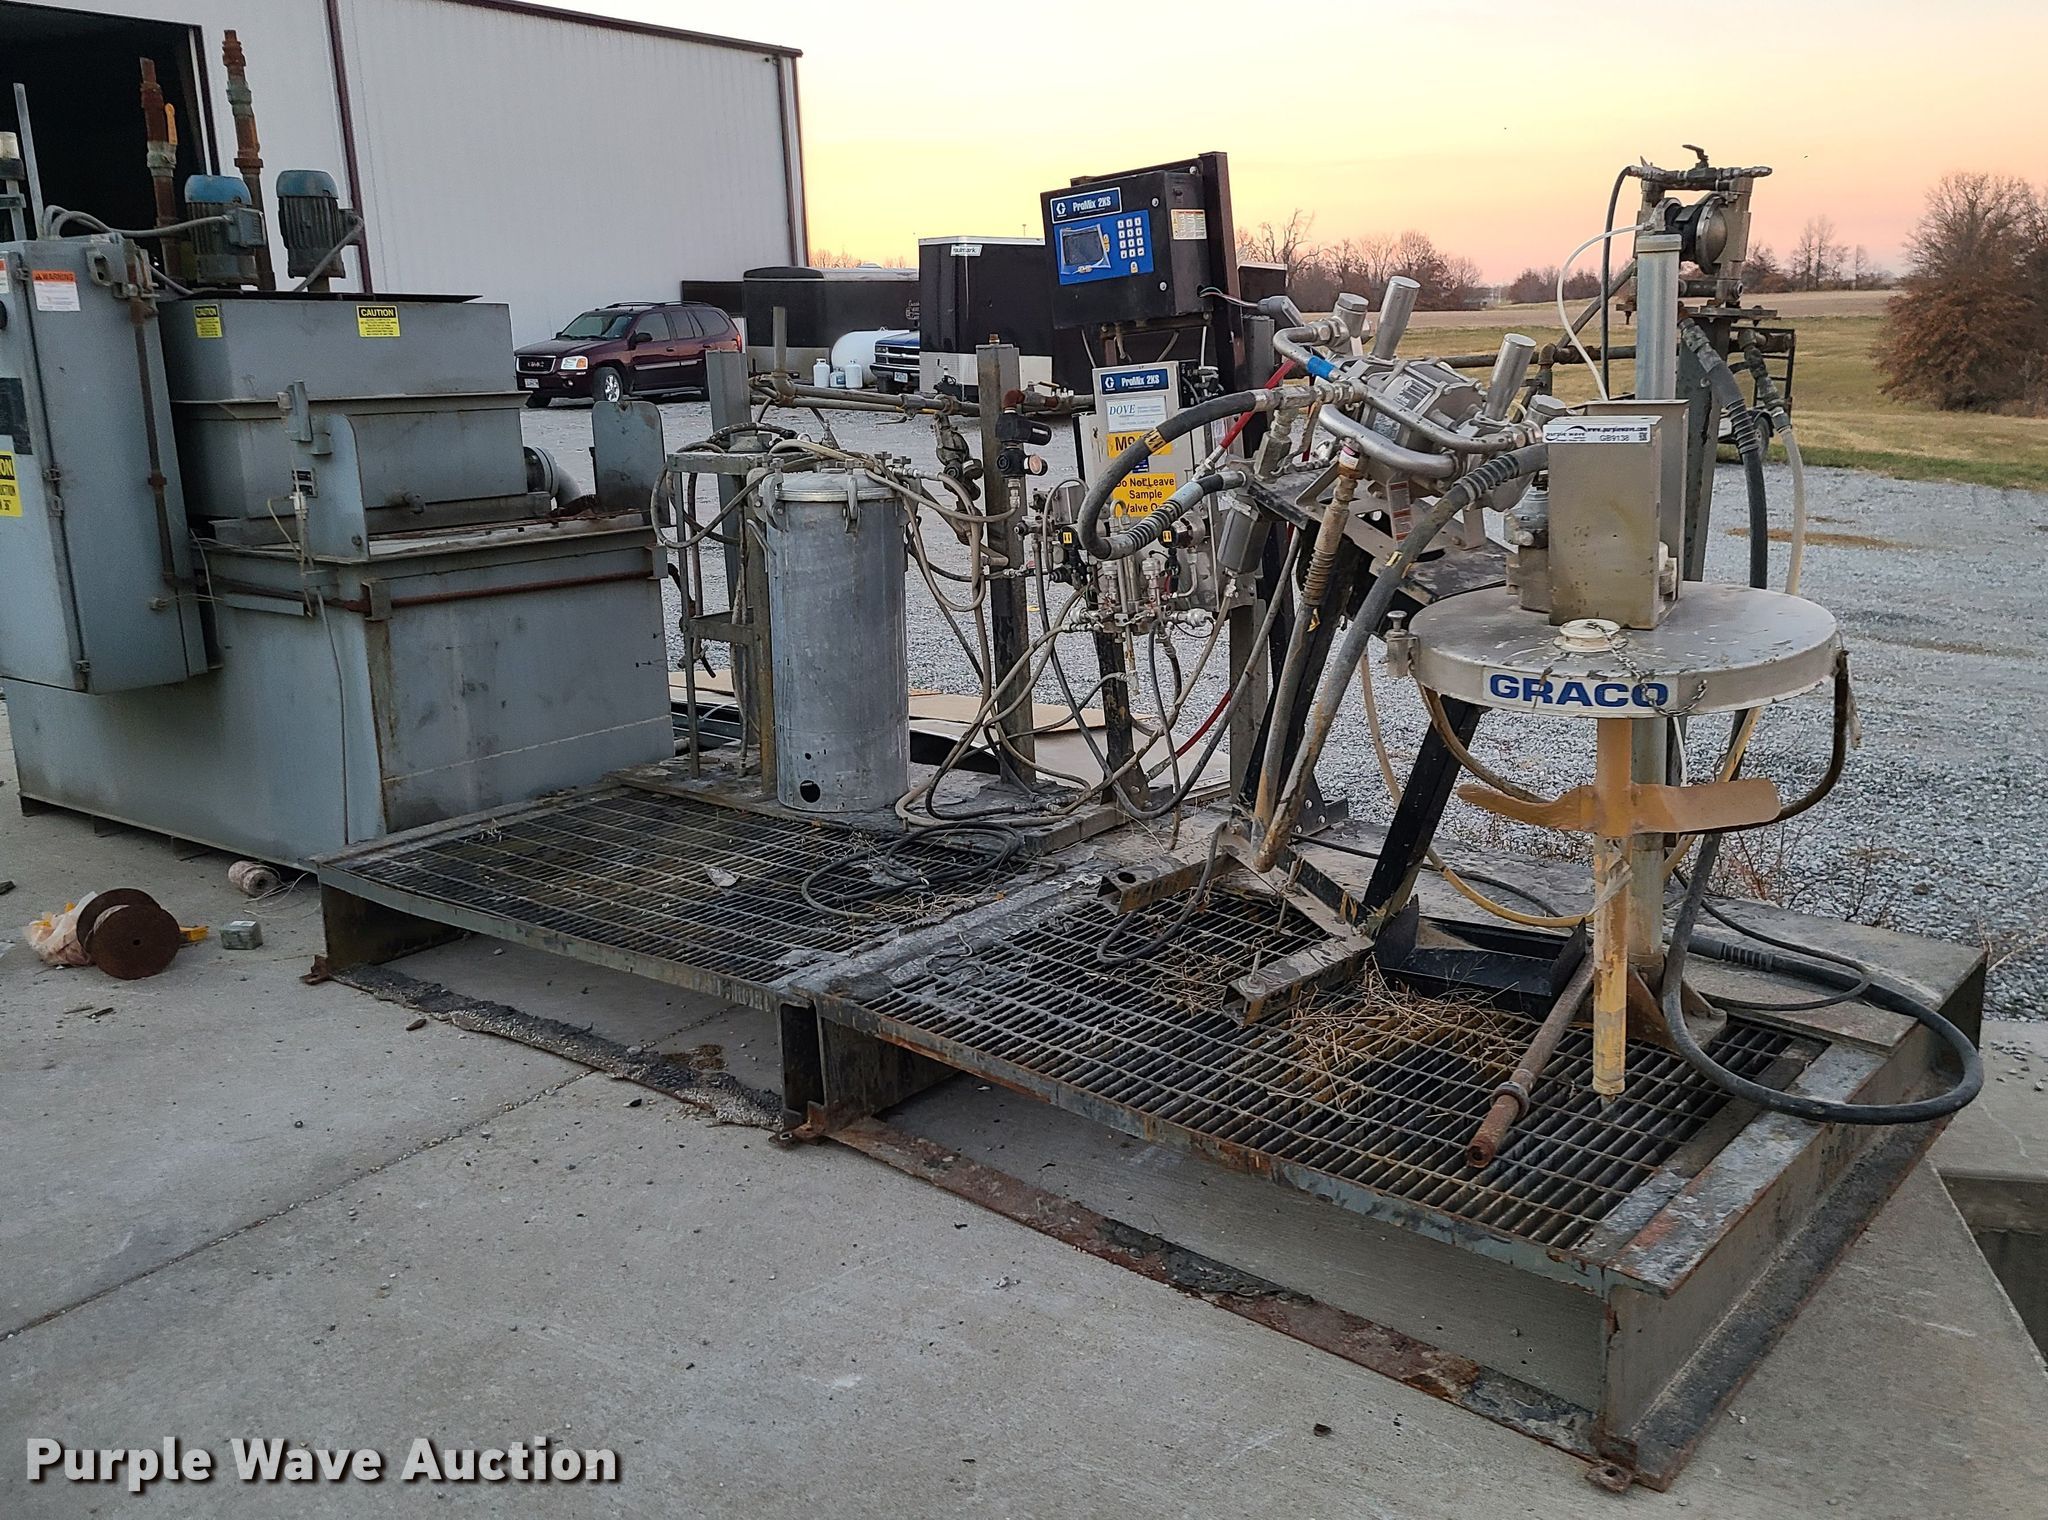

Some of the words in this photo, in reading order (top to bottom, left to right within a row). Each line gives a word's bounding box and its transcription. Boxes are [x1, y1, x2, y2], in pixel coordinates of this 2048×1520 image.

[1072, 199, 1097, 213] ProMix
[1097, 196, 1112, 208] 2KS
[360, 308, 395, 317] CAUTION
[1121, 375, 1145, 388] ProMix
[1146, 374, 1160, 385] 2KS
[1109, 404, 1136, 416] DOVE
[1148, 477, 1175, 488] Leave
[1129, 489, 1163, 502] Sample
[1490, 674, 1668, 708] GRACO
